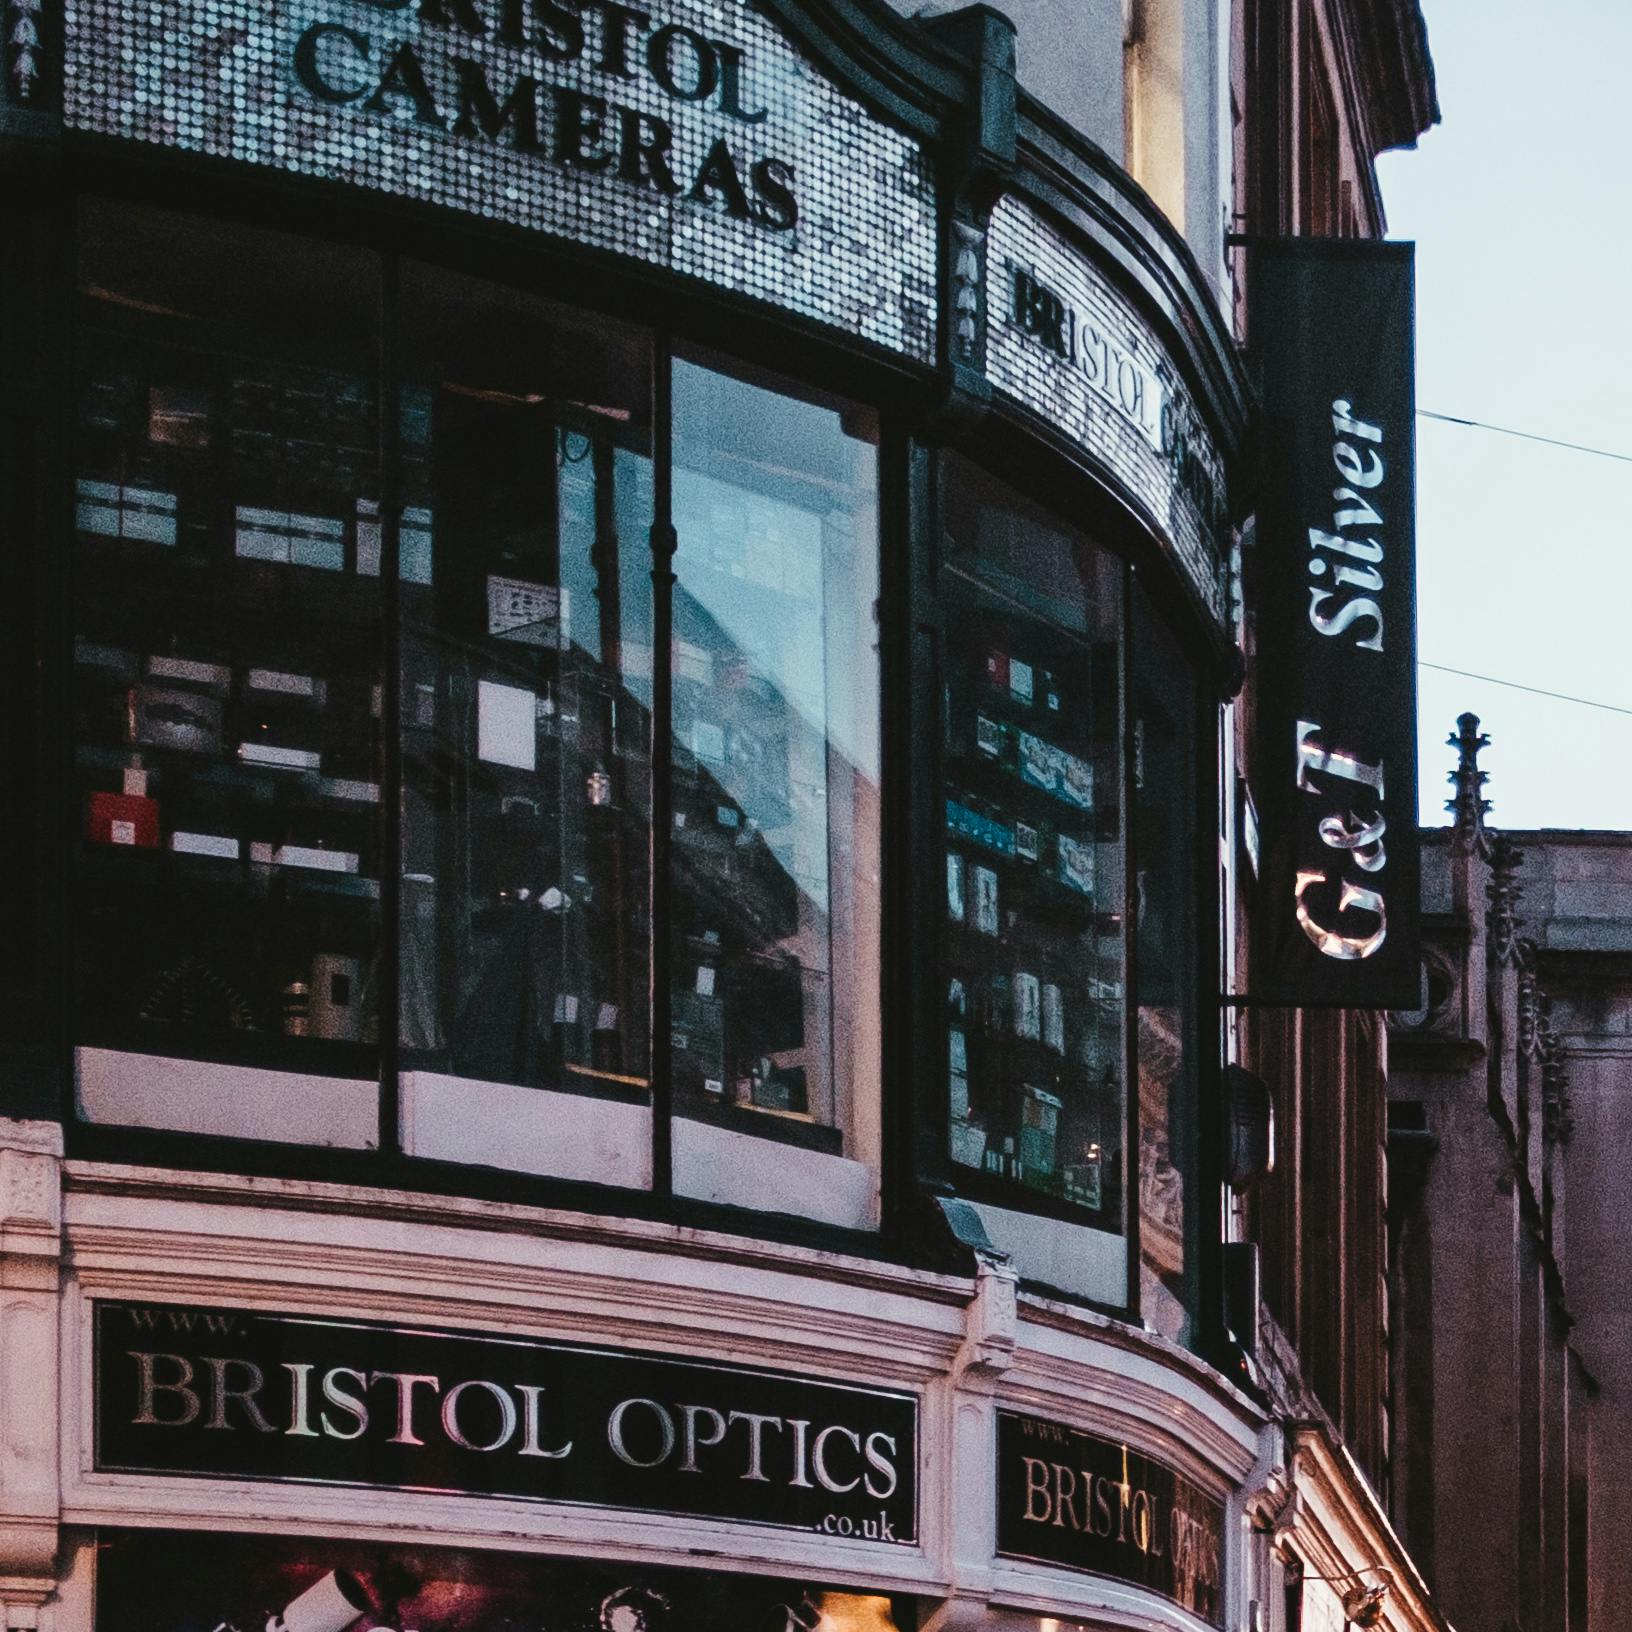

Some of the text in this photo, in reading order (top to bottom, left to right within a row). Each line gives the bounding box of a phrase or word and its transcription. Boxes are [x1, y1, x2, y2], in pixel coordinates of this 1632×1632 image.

[295, 23, 797, 231] CAMERAS
[370, 0, 768, 123] ISTOL
[1295, 400, 1388, 961] G&T Silver
[129, 1350, 897, 1499] BRISTOL OPTICS
[1021, 1456, 1163, 1557] BRISTOL
